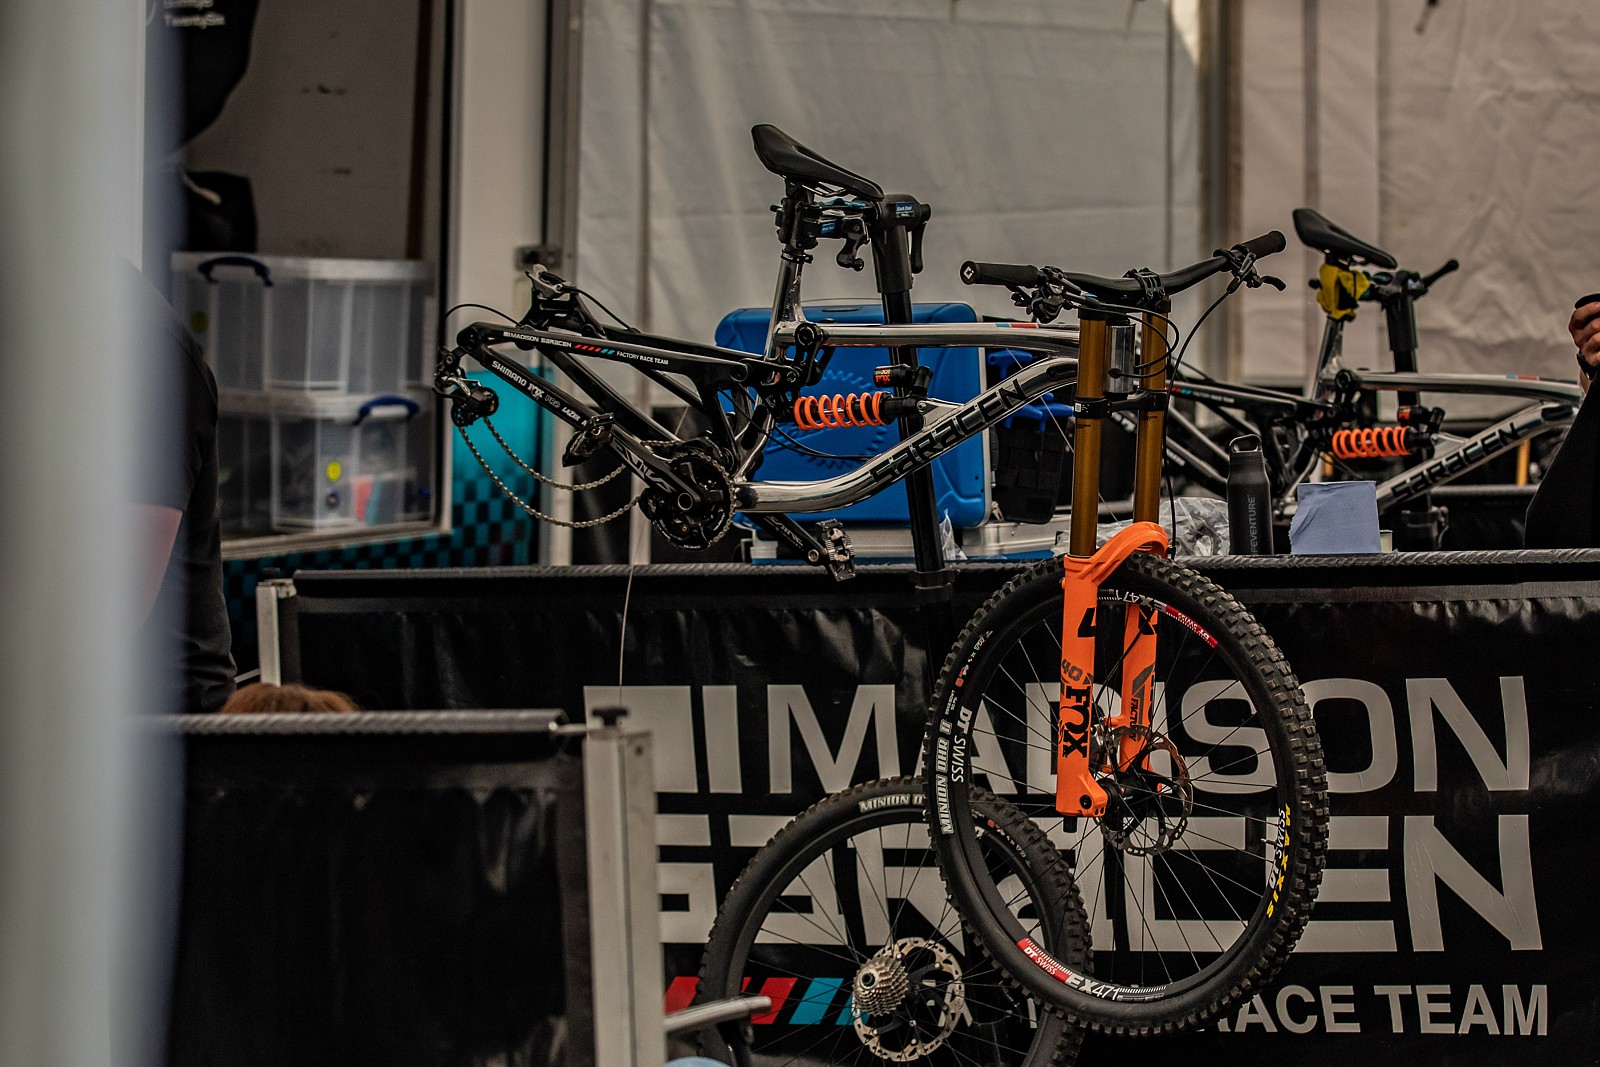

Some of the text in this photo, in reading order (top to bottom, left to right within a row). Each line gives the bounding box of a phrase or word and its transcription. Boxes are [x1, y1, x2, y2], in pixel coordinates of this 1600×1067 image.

[511, 333, 540, 342] MADISON
[616, 350, 669, 365] FACTORY RACE TEAM
[491, 360, 527, 387] SHIMANO
[561, 406, 581, 421] LAZER
[1248, 495, 1259, 554] FEVENTURE
[1177, 611, 1211, 641] DT SWISS
[951, 705, 973, 783] DT SWISS
[1059, 685, 1091, 759] FOX
[1128, 698, 1139, 742] FACTOY
[858, 793, 911, 814] MINION
[935, 773, 955, 835] MINION
[1275, 807, 1286, 860] SWISS
[1266, 803, 1291, 919] MAXXIS
[1023, 946, 1058, 975] DT SWISS
[1200, 983, 1549, 1037] ACE TEAM
